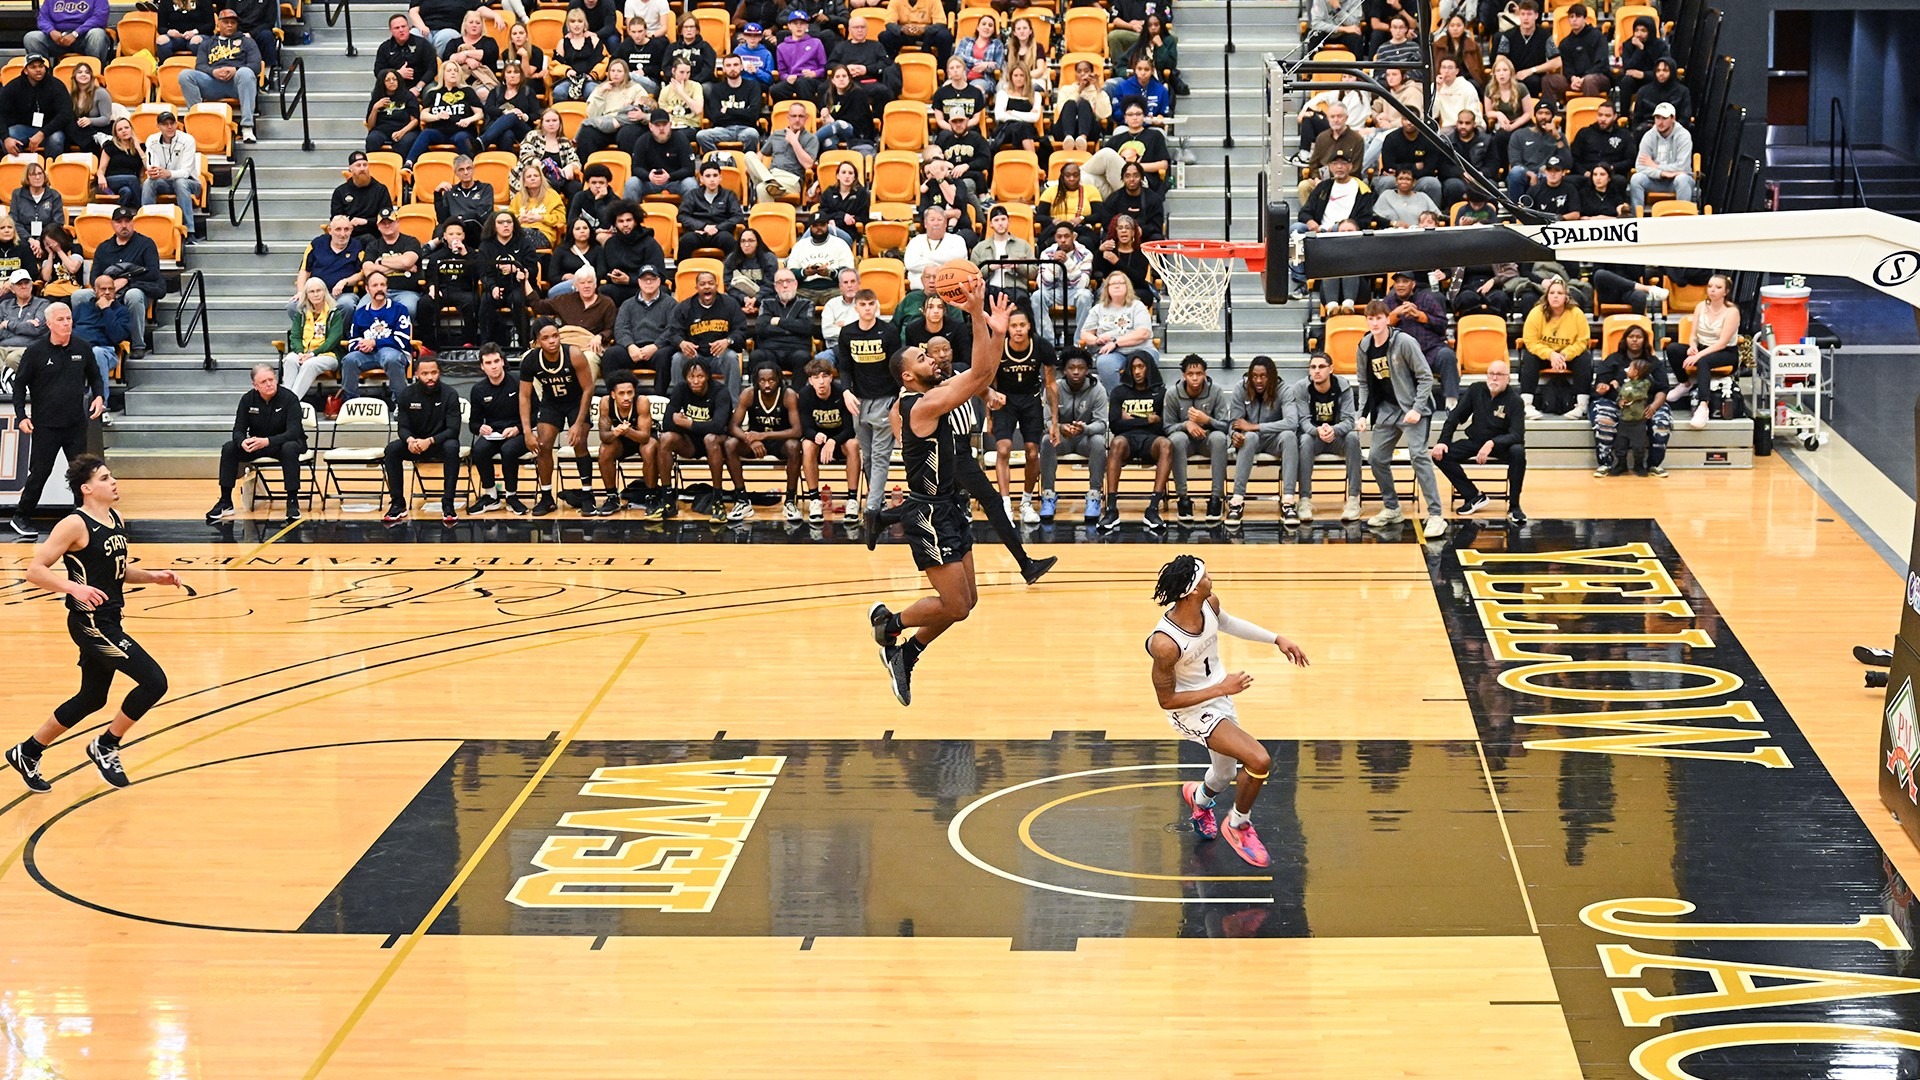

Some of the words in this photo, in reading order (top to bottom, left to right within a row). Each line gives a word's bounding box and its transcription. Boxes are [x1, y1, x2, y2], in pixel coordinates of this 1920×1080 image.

[435, 93, 442, 106] I
[431, 103, 465, 115] STATE
[1540, 222, 1638, 247] SPALDING
[1890, 257, 1906, 281] S
[398, 315, 411, 329] 3
[850, 340, 884, 354] STATE
[1539, 335, 1571, 346] JACKETS
[1003, 365, 1036, 373] STATE
[1371, 356, 1389, 372] STA
[541, 375, 573, 385] STATE
[552, 384, 567, 397] 15
[346, 404, 382, 416] WVSU
[650, 403, 668, 415] SU
[686, 404, 711, 420] STATE
[1121, 400, 1153, 412] STATE
[756, 416, 781, 425] STATE
[813, 409, 841, 423] STATE
[115, 555, 126, 580] 13
[170, 556, 398, 566] RAINES
[433, 557, 655, 566] LESTER
[1456, 542, 1795, 769] YELLOW
[1203, 657, 1211, 677] 1
[504, 755, 788, 913] WVSU
